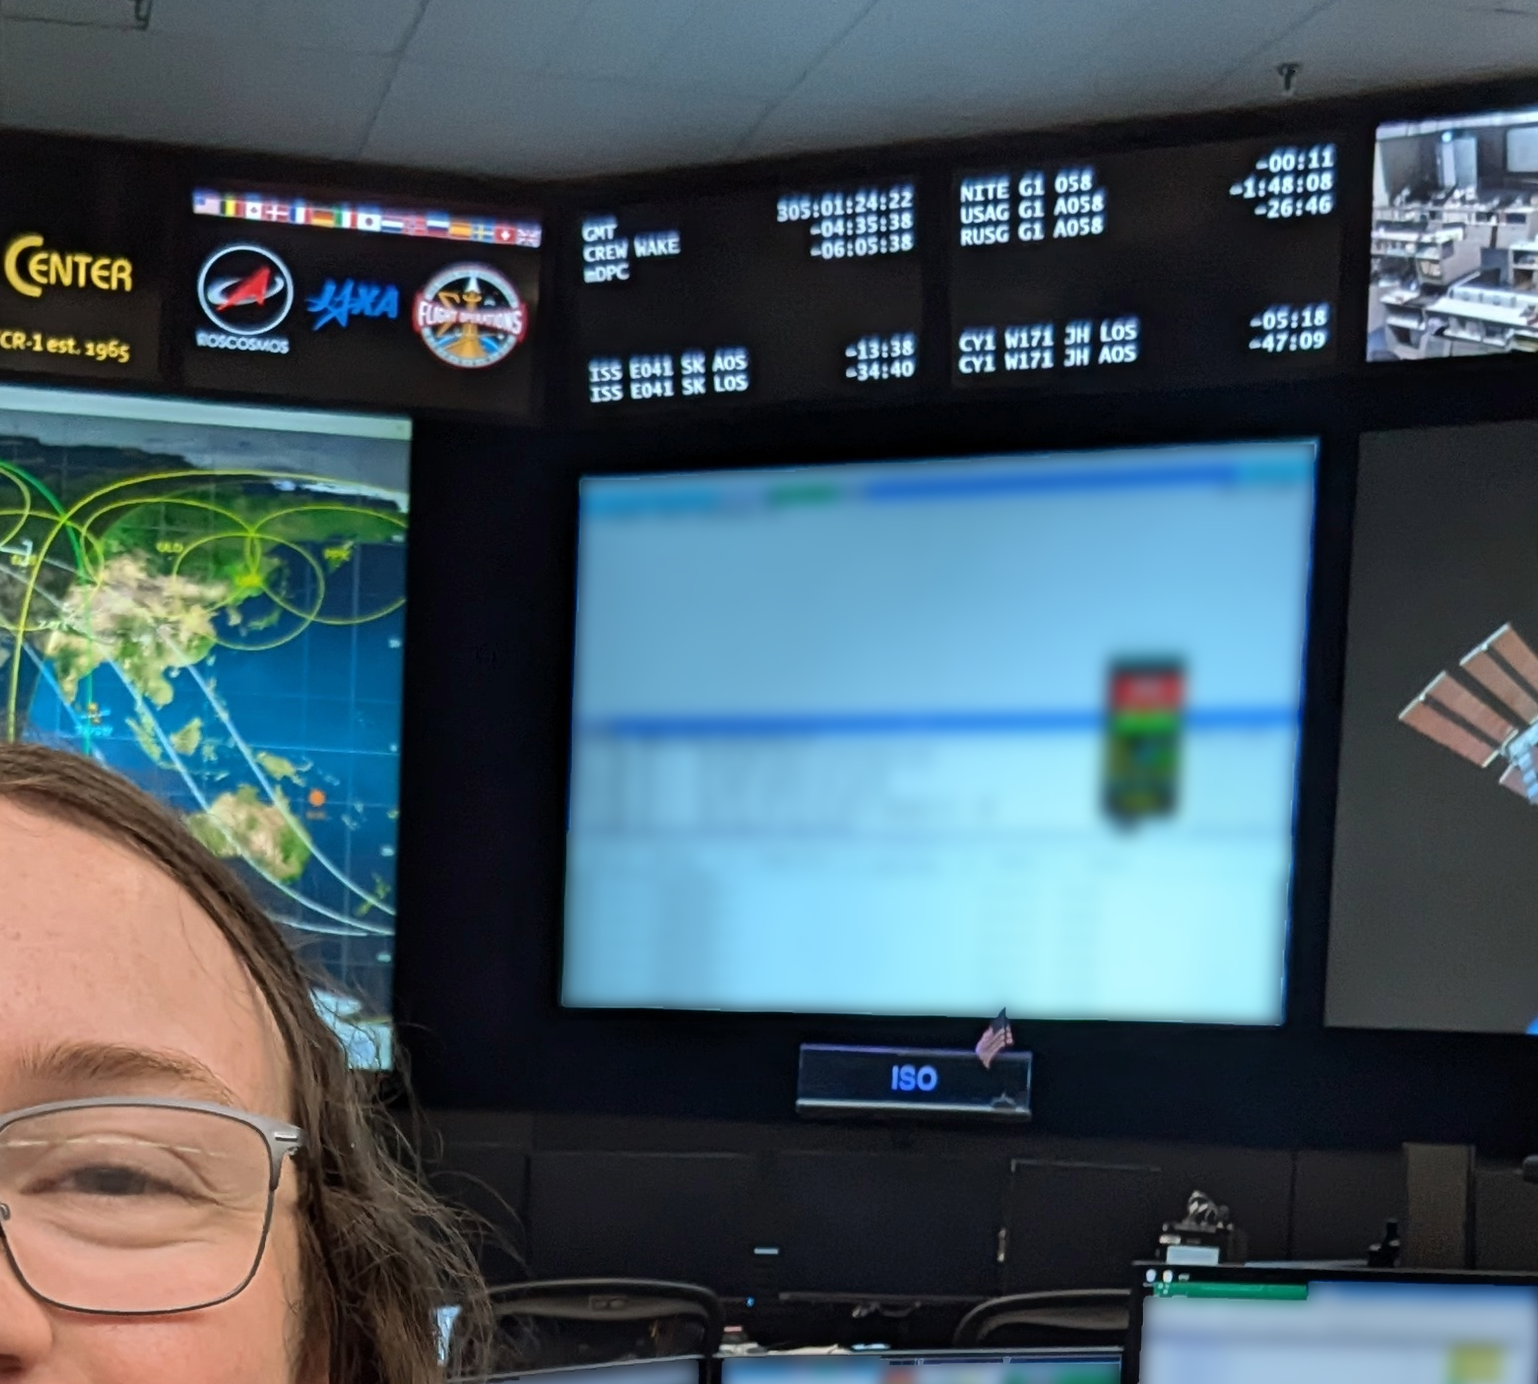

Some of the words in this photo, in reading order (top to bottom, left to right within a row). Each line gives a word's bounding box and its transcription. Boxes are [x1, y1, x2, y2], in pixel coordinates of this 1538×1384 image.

[1255, 146, 1335, 172] -00:11
[960, 178, 1010, 203] NITE
[1018, 173, 1045, 197] G1
[1228, 171, 1335, 199] -1:48:08
[776, 187, 913, 222] 305:01:24:22
[960, 203, 1010, 224] USAG
[1018, 198, 1045, 219] G1
[1053, 191, 1105, 216] A058
[1254, 194, 1334, 219] -26:46
[582, 219, 617, 242] GMT
[810, 211, 913, 238] -04:35:38
[960, 224, 1010, 246] RUSG
[1018, 220, 1045, 241] G1
[1052, 215, 1105, 238] A058
[583, 240, 628, 262] CREW
[634, 232, 681, 257] WAKE
[810, 233, 913, 259] -06:05:38
[307, 278, 400, 331] JAXA
[1249, 303, 1329, 330] -05:18
[195, 329, 290, 354] ROSCOSMOS
[958, 329, 996, 351] CY1
[1004, 324, 1054, 349] W171
[1100, 315, 1140, 342] LOS
[1248, 329, 1329, 352] -47:09
[46, 334, 81, 355] est.
[84, 339, 130, 363] 1965
[845, 335, 915, 360] -13:38
[958, 351, 996, 373] CY1
[1004, 347, 1054, 371] W171
[1098, 340, 1139, 364] AOS
[589, 360, 623, 382] ISS
[629, 355, 674, 379] E041
[712, 348, 749, 372] AOS
[845, 359, 915, 381] -34:40
[590, 382, 624, 403] ISS
[630, 379, 675, 399] E041
[713, 371, 750, 392] LOS
[891, 1064, 938, 1092] ISO
